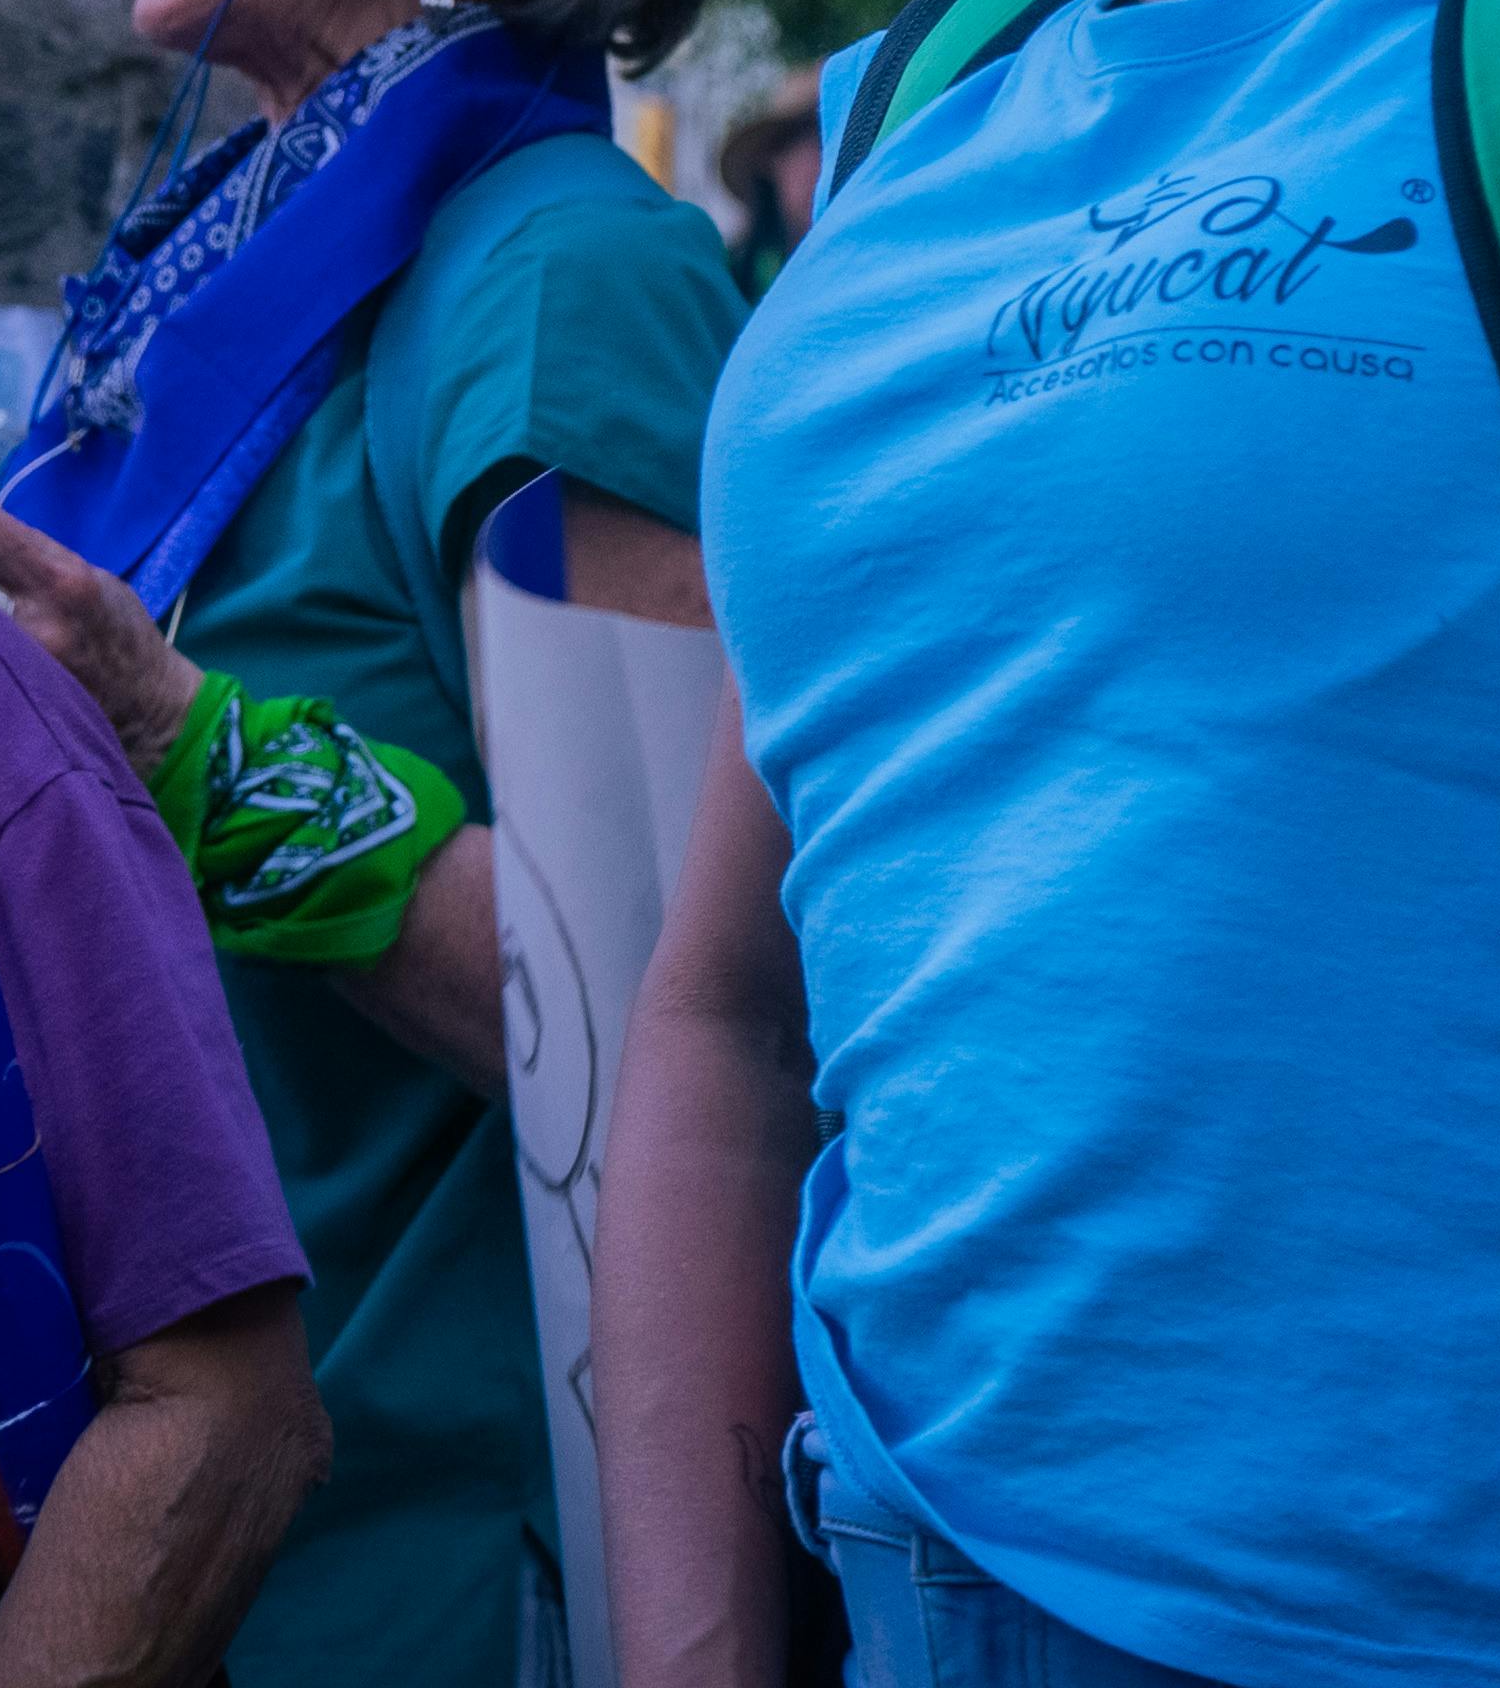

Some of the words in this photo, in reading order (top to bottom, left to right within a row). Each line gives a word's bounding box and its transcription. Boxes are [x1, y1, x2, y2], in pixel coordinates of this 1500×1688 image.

[984, 338, 1160, 407] Accesorios
[1171, 336, 1257, 366] con
[1268, 342, 1415, 382] causa
